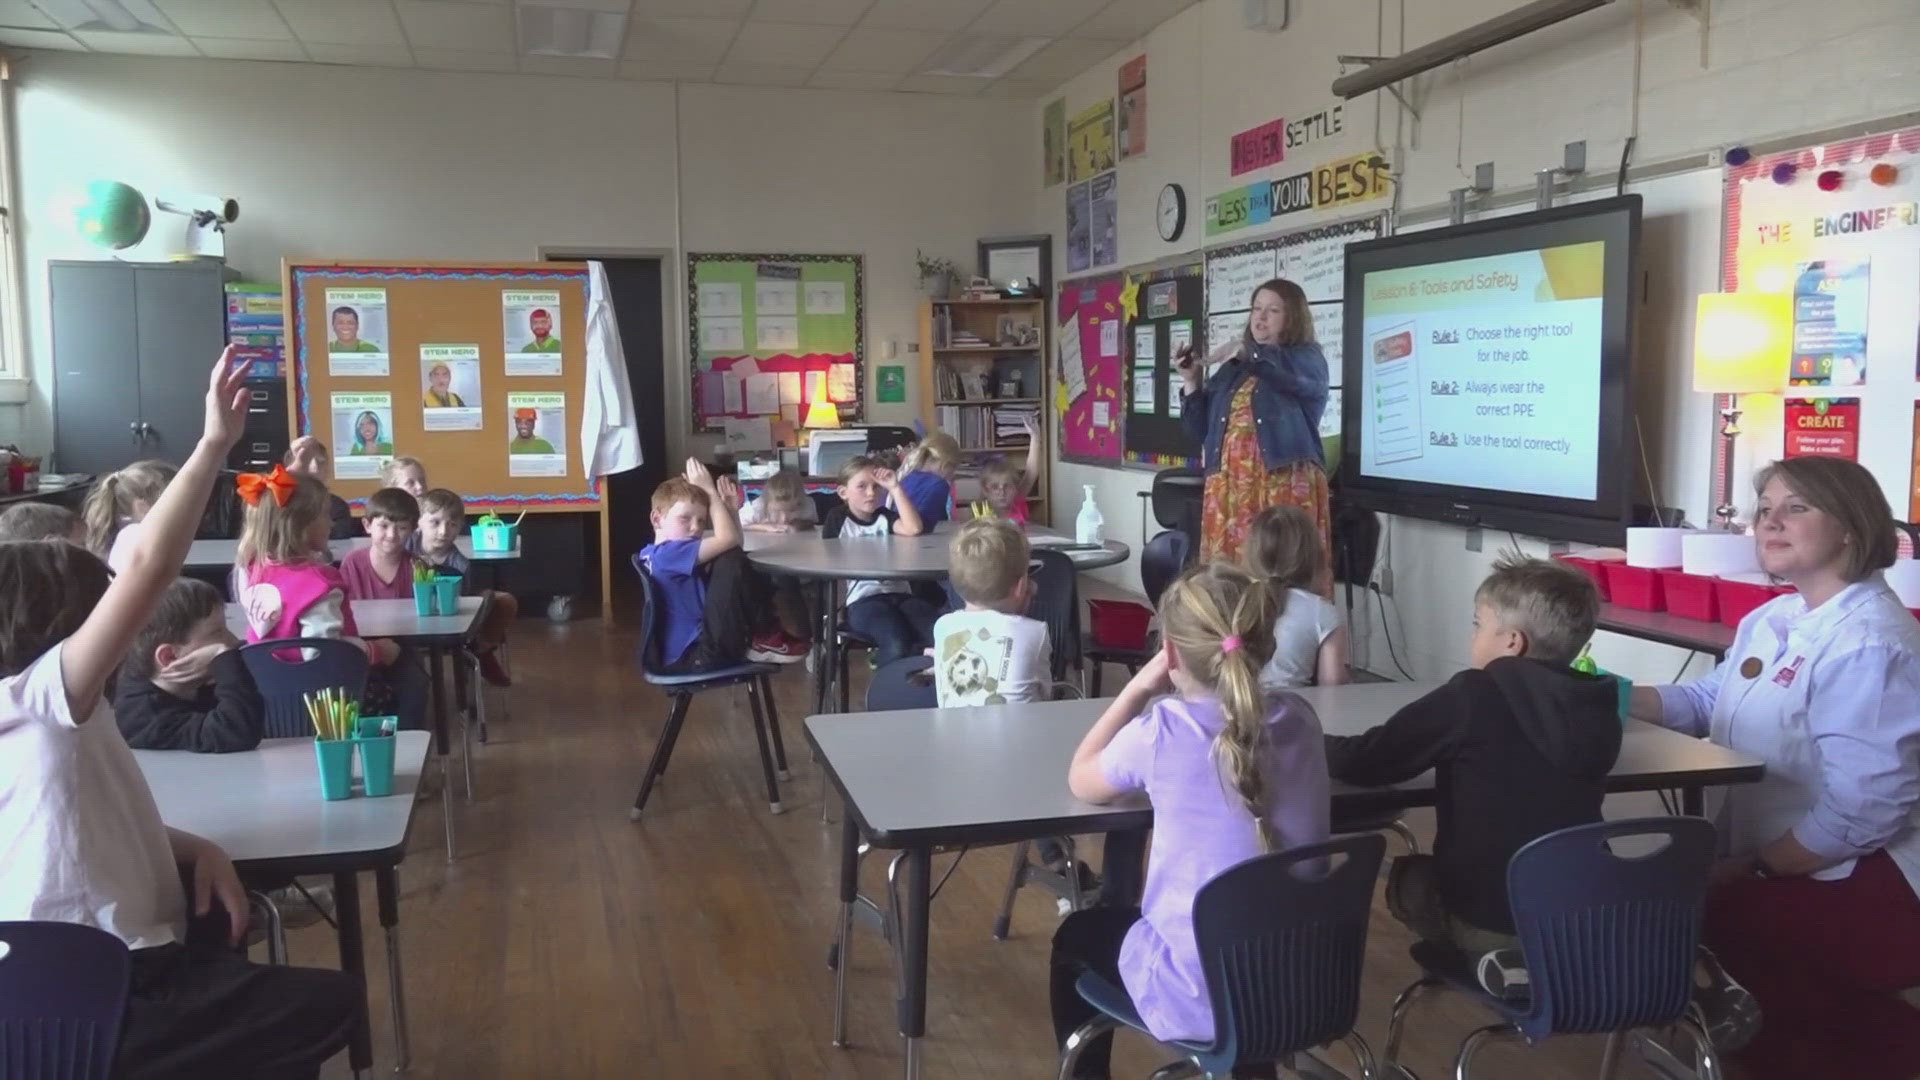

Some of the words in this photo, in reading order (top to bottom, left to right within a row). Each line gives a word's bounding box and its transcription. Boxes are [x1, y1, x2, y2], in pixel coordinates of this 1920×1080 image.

[1232, 131, 1280, 170] NEVER
[1286, 105, 1343, 148] SETTLE
[1219, 197, 1247, 227] LESS
[1272, 177, 1311, 213] YOUR
[1757, 221, 1792, 245] THE
[1420, 280, 1448, 296] Tools
[1451, 274, 1474, 292] and
[1476, 271, 1519, 291] Safety
[329, 292, 355, 300] STEM
[357, 292, 384, 300] HERO
[505, 294, 531, 302] STEM
[532, 294, 557, 302] HERO
[1432, 328, 1451, 344] Rule
[1466, 327, 1502, 341] Choose
[1504, 325, 1521, 338] the
[1523, 324, 1549, 341] right
[1551, 322, 1573, 336] tool
[423, 348, 449, 356] STEM
[450, 348, 476, 356] HERO
[1477, 348, 1490, 362] for
[1493, 349, 1509, 362] the
[1431, 380, 1451, 395] Rule
[1465, 381, 1498, 396] Always
[1499, 382, 1524, 394] wear
[1527, 380, 1545, 394] the
[334, 396, 360, 404] STEM
[362, 396, 388, 404] HERO
[1475, 403, 1510, 416] correct
[1797, 415, 1845, 428] CREATE
[1430, 431, 1449, 447] Rule
[1464, 433, 1484, 446] Use
[1484, 433, 1500, 448] the
[1502, 435, 1521, 449] tool
[1523, 438, 1570, 455] correctly
[487, 534, 494, 545] 4
